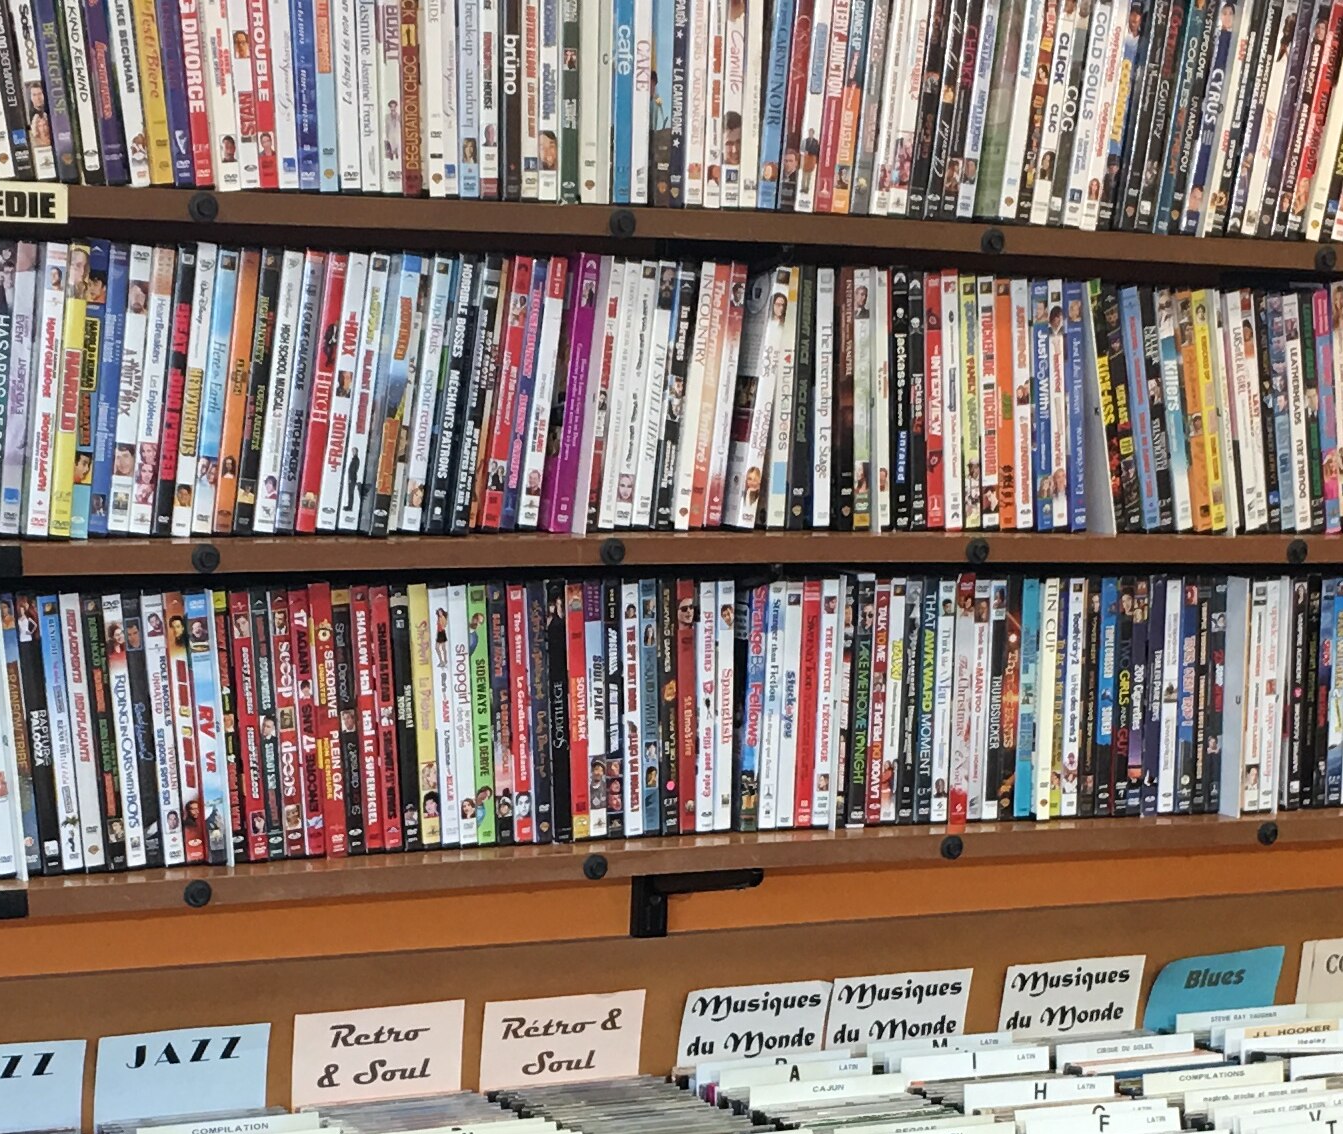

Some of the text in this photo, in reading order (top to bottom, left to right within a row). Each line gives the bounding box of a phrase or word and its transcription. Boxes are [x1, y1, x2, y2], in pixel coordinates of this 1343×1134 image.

[184, 18, 205, 114] DIVORCE
[404, 55, 417, 96] CHOC
[503, 34, 519, 95] brüno
[635, 39, 651, 93] CAKE
[1082, 11, 1108, 121] COLD SOULS
[928, 354, 942, 436] INTERVIEW
[1165, 360, 1179, 412] Killers
[1045, 618, 1056, 654] CUP
[475, 658, 488, 715] SIDEWAYS
[919, 629, 935, 775] AWKWARD MOMENT
[576, 677, 587, 741] SOUTH PARK
[720, 668, 733, 745] Spanglish
[989, 674, 1002, 750] THUMBSUCKER
[838, 977, 962, 1007] Musiques
[1011, 967, 1130, 997] Musiques
[1184, 967, 1245, 990] Blues
[692, 990, 821, 1020] Musiques
[1007, 1002, 1123, 1031] du Monde
[502, 1008, 622, 1040] Rétro &
[833, 1015, 957, 1045] du Monde
[1282, 1024, 1331, 1036] HOOKER
[125, 1037, 241, 1069] JAZZ
[687, 1029, 816, 1057] du Monde
[318, 1058, 432, 1087] & Soul
[521, 1050, 596, 1075] Soul
[1179, 1070, 1245, 1082] COMPILATIONS
[812, 1083, 845, 1094] CAJUN
